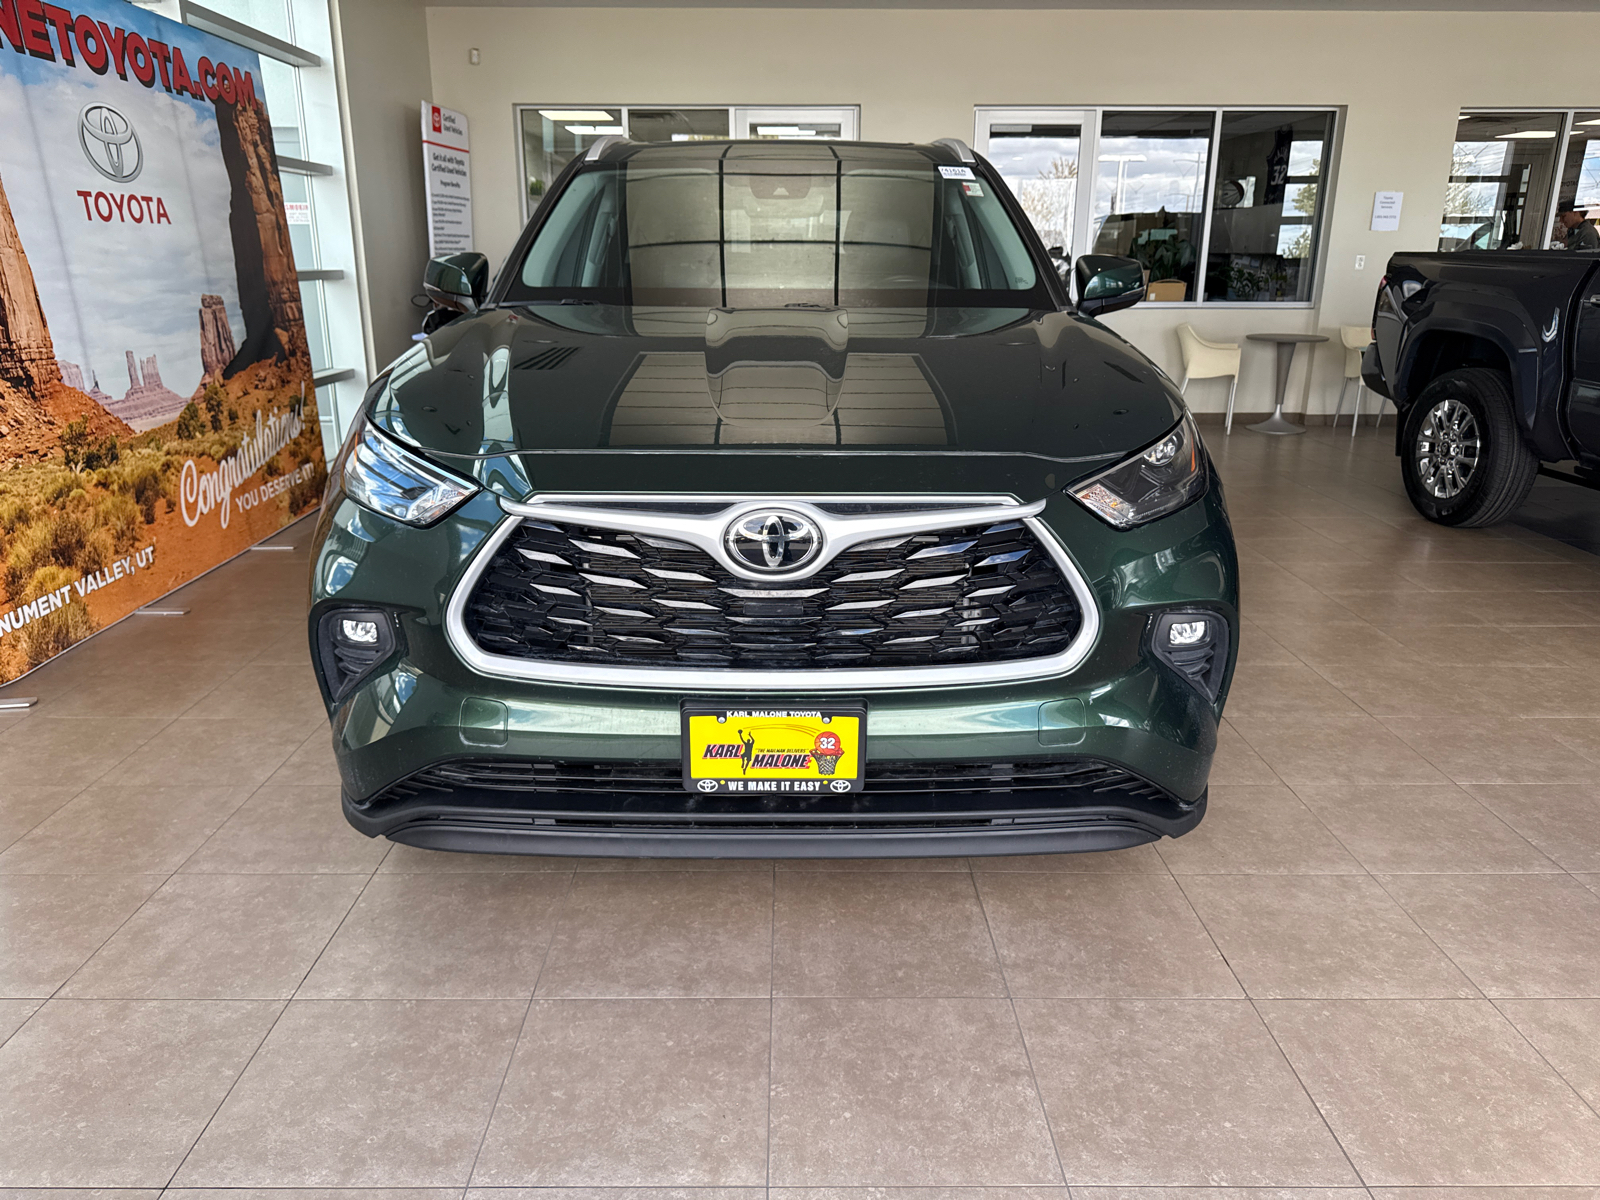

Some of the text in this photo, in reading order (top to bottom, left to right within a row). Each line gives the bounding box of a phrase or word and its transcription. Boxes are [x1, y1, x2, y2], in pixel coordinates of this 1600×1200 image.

[1270, 164, 1287, 186] 32
[76, 190, 172, 225] TOYOTA
[180, 381, 306, 529] Congratulations!
[236, 462, 315, 513] YOU DESERVE IT!
[0, 545, 154, 638] NUMENT VALLEY, UT
[703, 744, 743, 759] KARL
[820, 737, 836, 749] 32
[751, 754, 811, 769] MALONE
[728, 781, 820, 791] WE MAKE IT EASY
